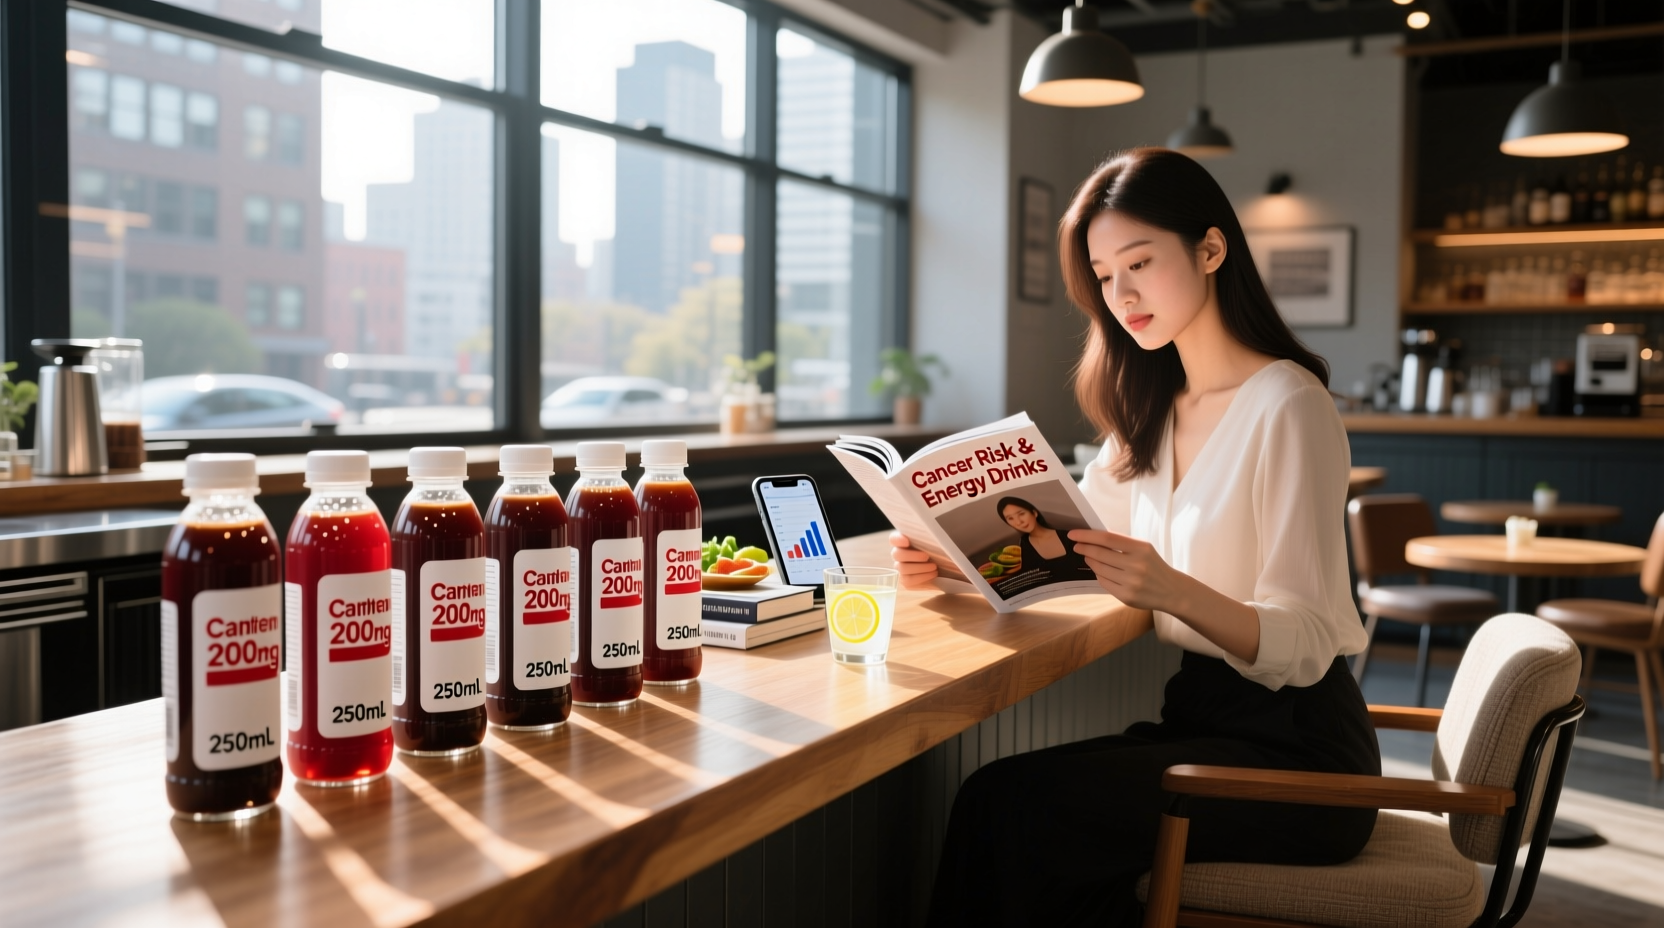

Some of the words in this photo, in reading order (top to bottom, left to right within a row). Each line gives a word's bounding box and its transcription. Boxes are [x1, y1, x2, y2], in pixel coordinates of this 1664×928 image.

[911, 456, 974, 488] Cancer
[974, 442, 1017, 467] Risk
[1017, 437, 1036, 455] &
[920, 475, 987, 509] Energy
[986, 458, 1049, 485] Drinks
[432, 602, 485, 628] 200ng
[329, 619, 391, 646] 200ng
[208, 639, 279, 668] 200ng
[433, 678, 483, 700] 250mL
[332, 700, 387, 724] 250mL
[209, 727, 275, 754] 250mL
